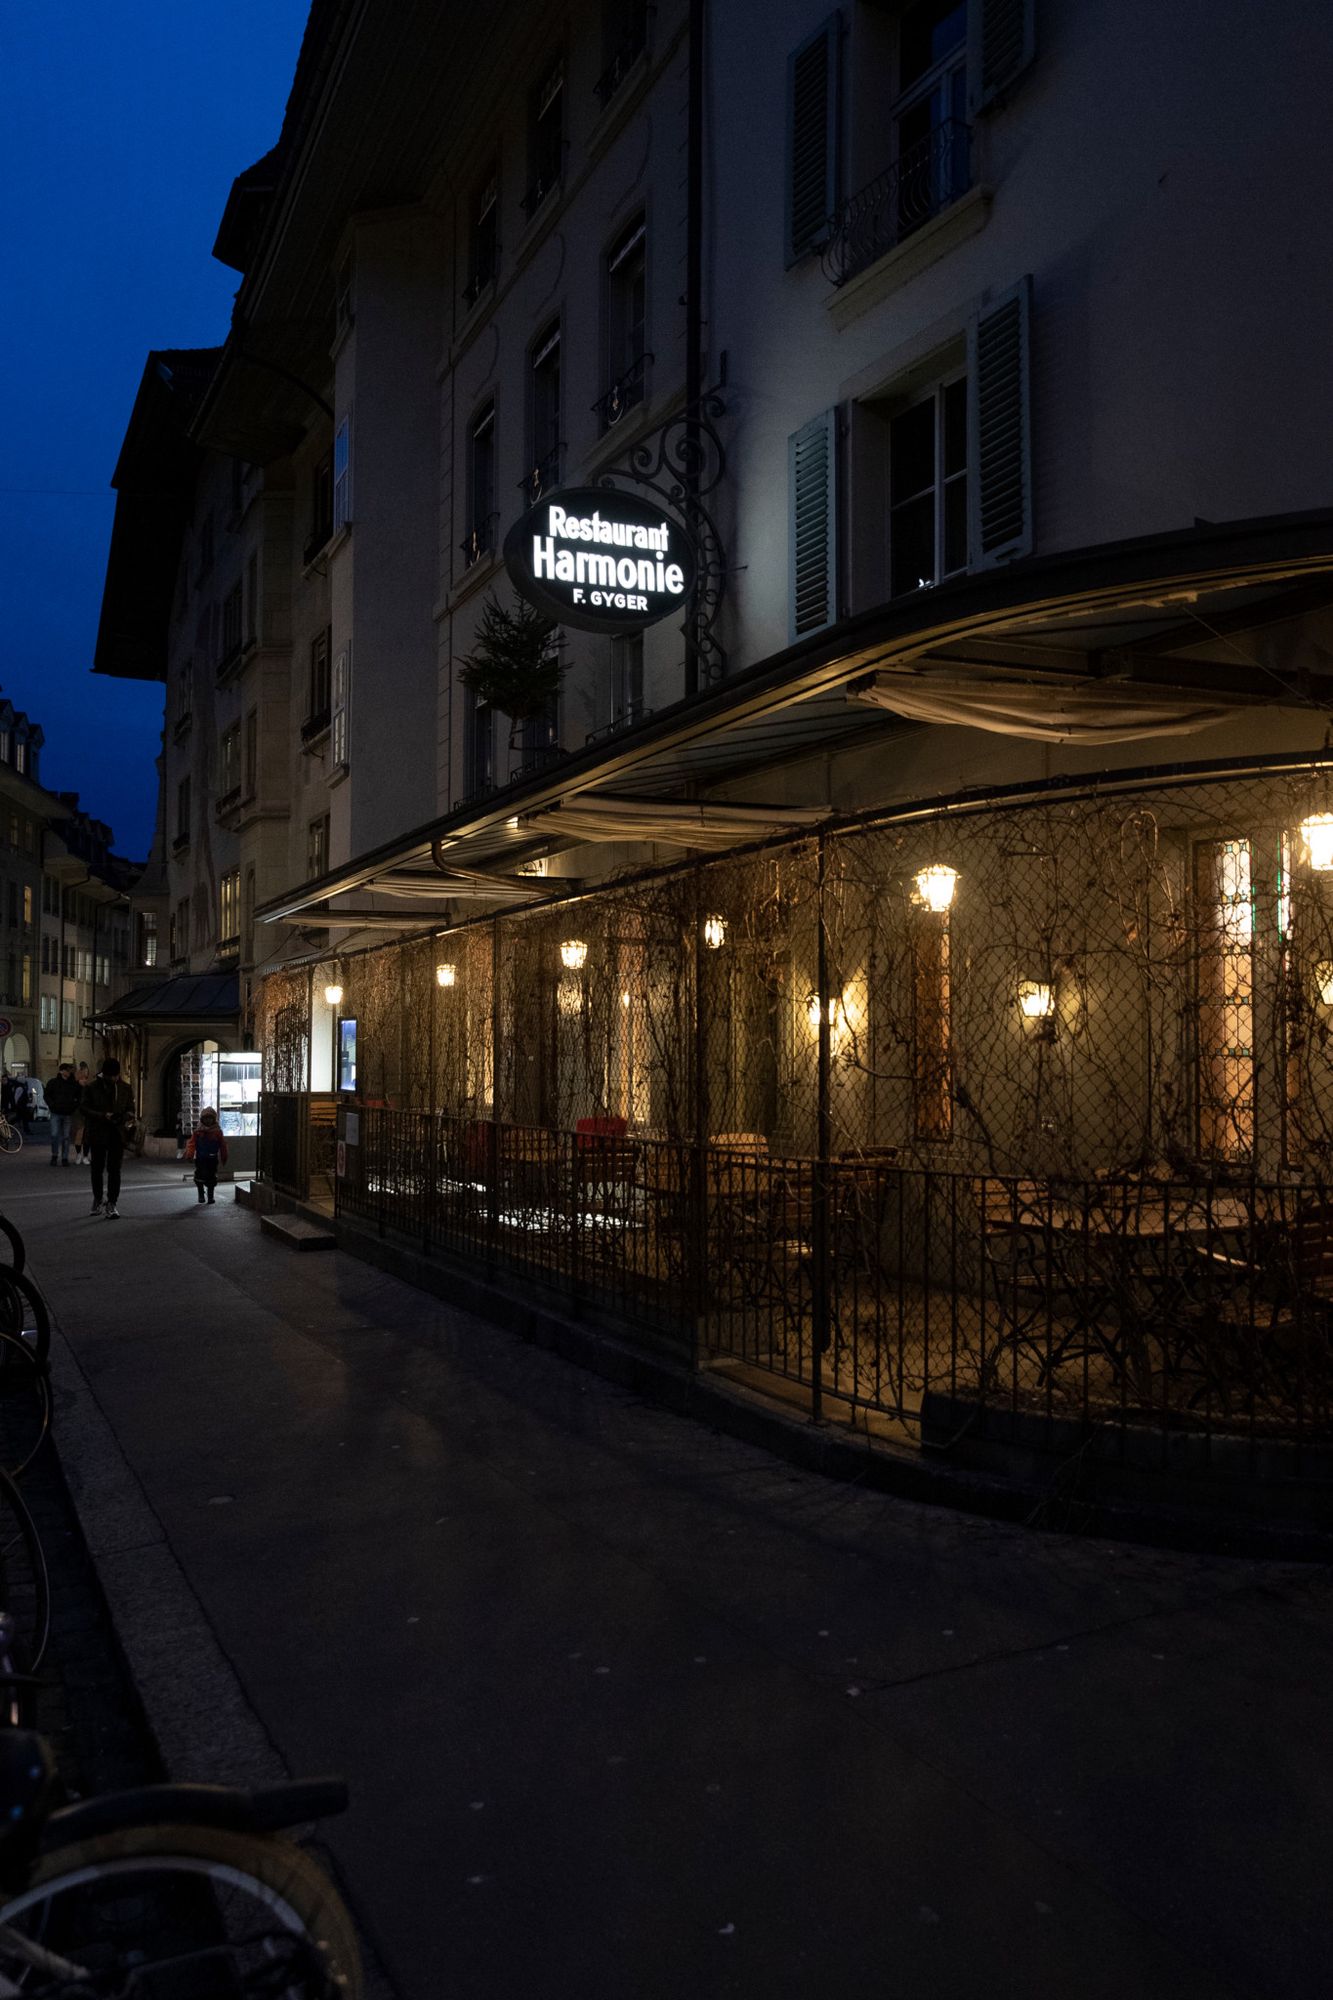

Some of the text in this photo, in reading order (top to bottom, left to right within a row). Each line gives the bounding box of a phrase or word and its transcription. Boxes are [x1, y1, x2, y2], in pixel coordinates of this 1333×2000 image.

[548, 505, 670, 551] Restaurant
[532, 535, 684, 594] Harmonie
[572, 588, 648, 611] F. GYGER
